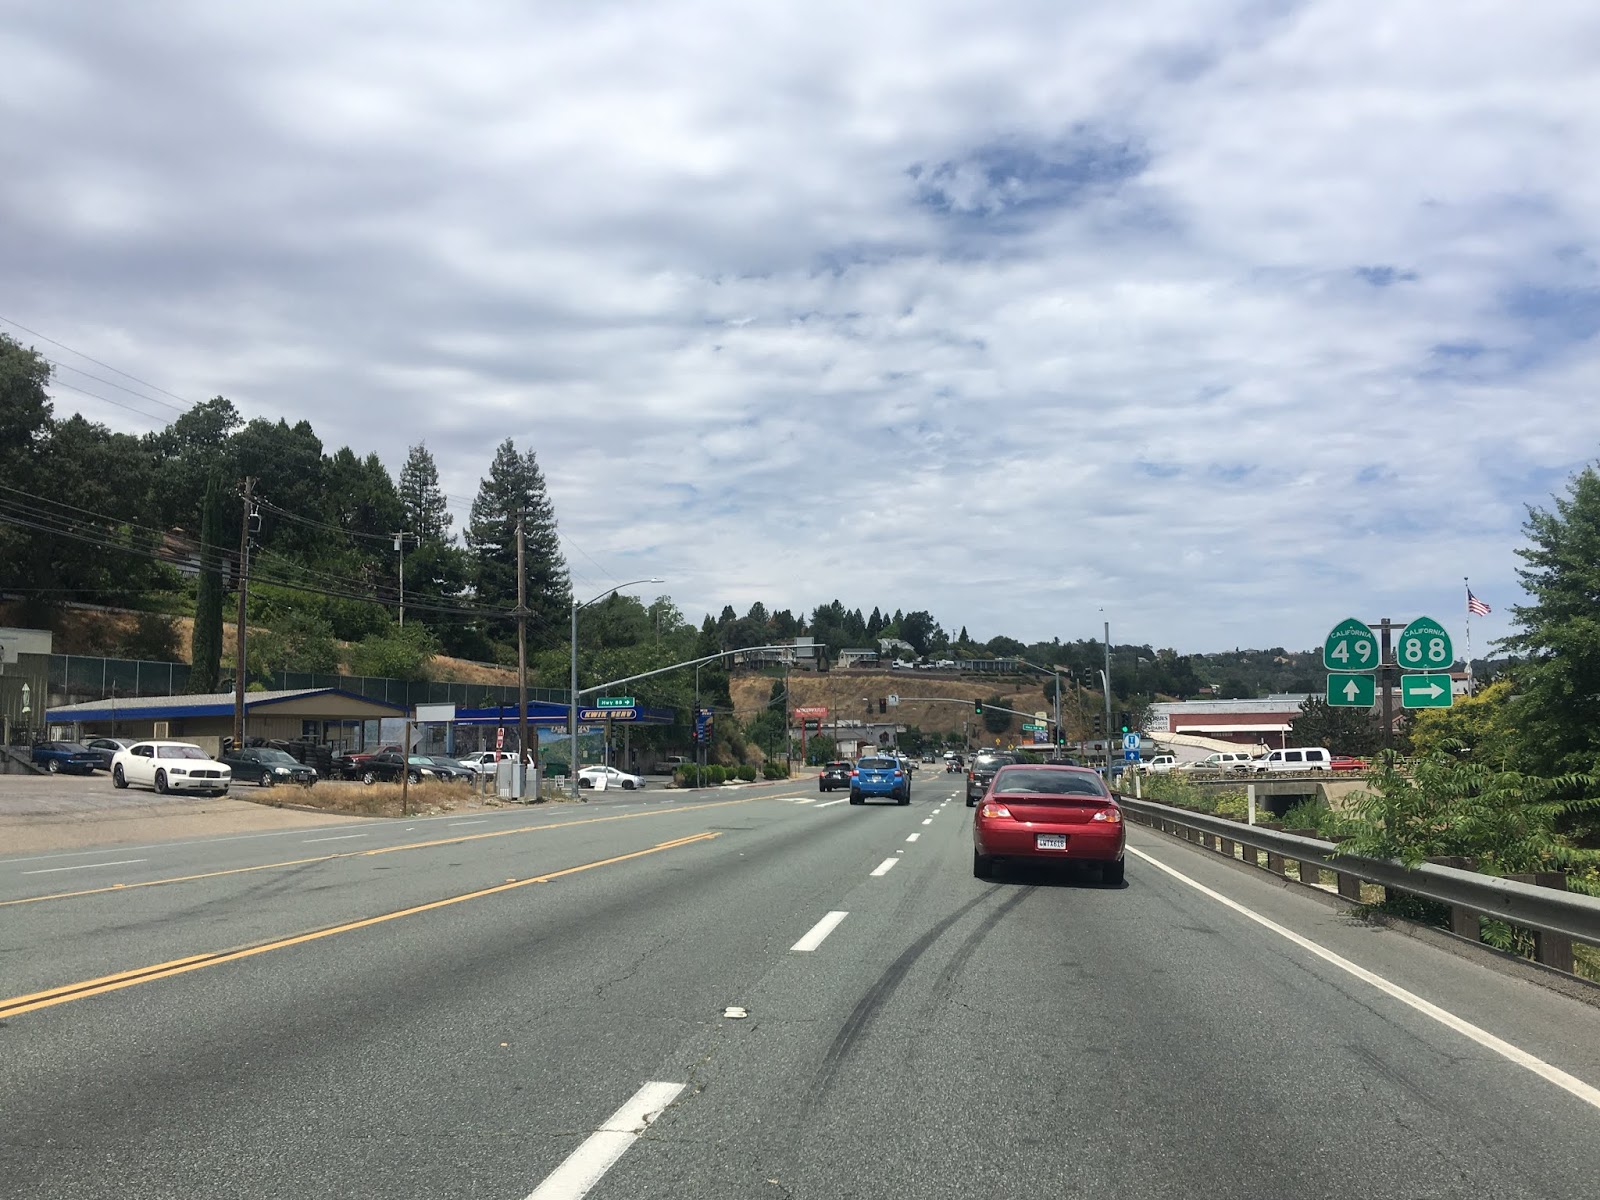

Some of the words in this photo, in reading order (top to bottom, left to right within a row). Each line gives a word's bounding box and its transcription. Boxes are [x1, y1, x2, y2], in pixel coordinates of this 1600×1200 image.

[1331, 629, 1371, 639] CALIFORNIA
[1404, 627, 1445, 637] CALIFORNIA
[1331, 639, 1372, 663] 49
[1405, 638, 1446, 662] 88
